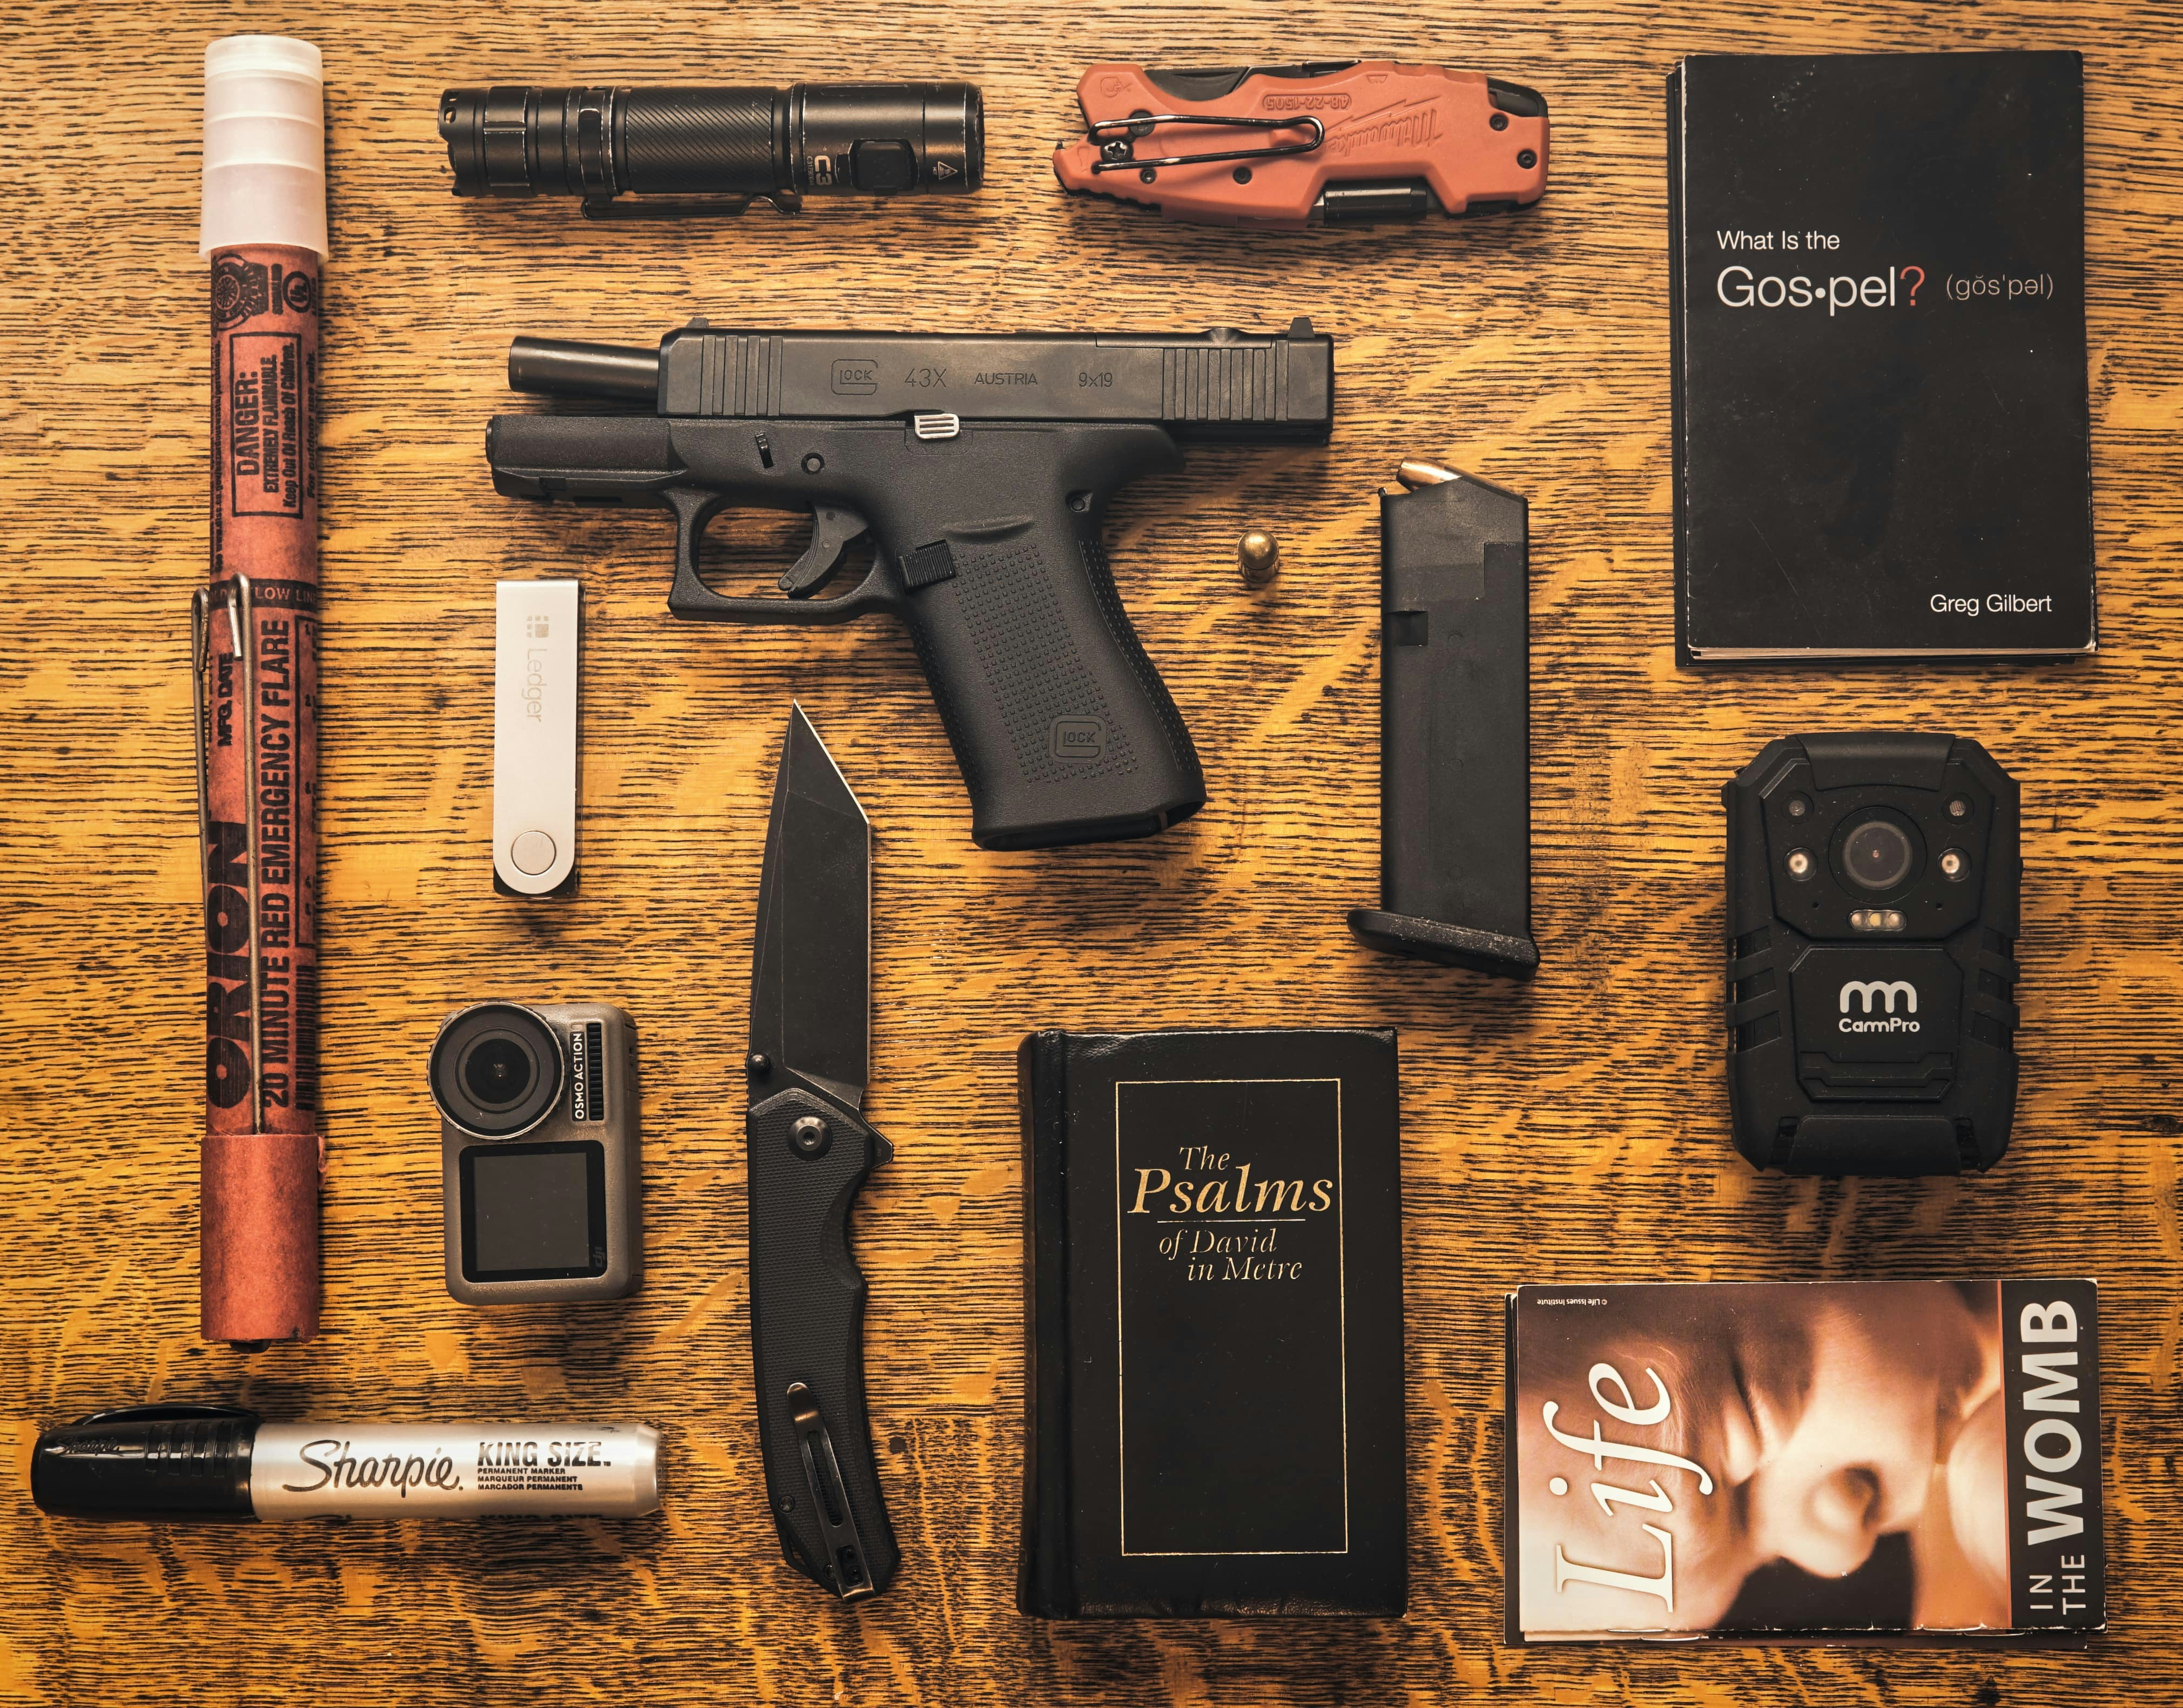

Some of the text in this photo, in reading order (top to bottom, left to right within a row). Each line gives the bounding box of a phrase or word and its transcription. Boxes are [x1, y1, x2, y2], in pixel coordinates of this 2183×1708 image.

[1266, 96, 1350, 111] 48-22-1505
[1326, 109, 1443, 157] Milwaukee
[814, 155, 832, 186] C3
[1716, 230, 1840, 250] What Is the
[831, 359, 1113, 395] GLOCK 43X AUSTRIA 9x19
[281, 392, 295, 404] Of
[307, 387, 315, 412] use
[235, 371, 260, 475] DANGER:
[260, 354, 279, 493] EXTREMELY FLAMMABLE
[281, 408, 296, 441] Reach
[282, 443, 296, 456] Of
[306, 415, 315, 471] outdoor
[282, 458, 297, 478] Out
[282, 480, 298, 508] Keep
[307, 473, 315, 498] For
[250, 586, 291, 601] LOW
[1930, 593, 2052, 617] Greg Gilbert
[218, 652, 233, 698] DATE
[521, 648, 548, 722] Ledger
[1054, 720, 1102, 758] GLOCK
[260, 620, 290, 1108] 20 MINUTE RED EMERGENCY FLARE
[206, 820, 251, 1109] ORION
[573, 1033, 585, 1119] OSMO ACTION
[1179, 1145, 1230, 1171] The
[1127, 1163, 1333, 1214] Psalms
[1159, 1227, 1277, 1261] of David
[1188, 1256, 1303, 1281] in Metre
[477, 1441, 538, 1467] KING
[2020, 1301, 2086, 1615] THE WOMB
[1543, 1363, 1714, 1613] Life
[2029, 1575, 2053, 1609] IN
